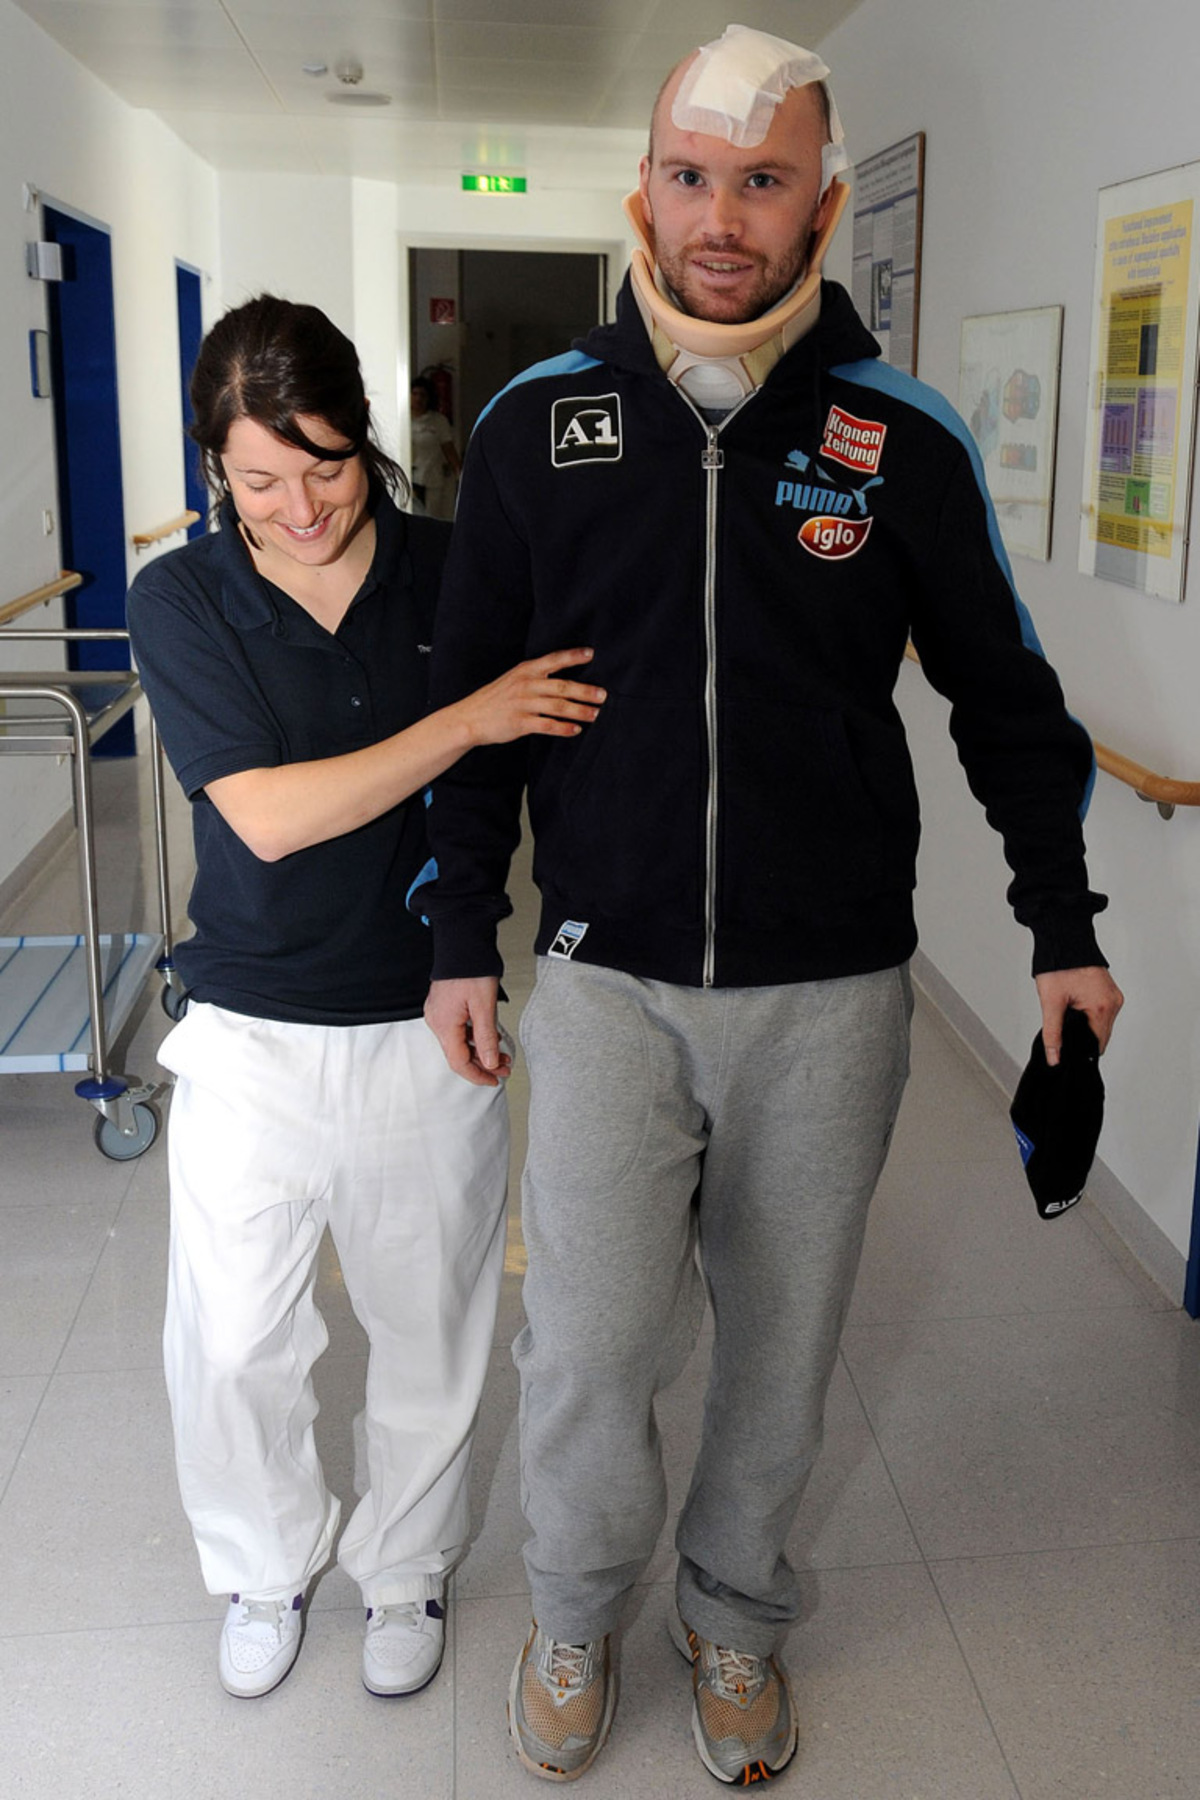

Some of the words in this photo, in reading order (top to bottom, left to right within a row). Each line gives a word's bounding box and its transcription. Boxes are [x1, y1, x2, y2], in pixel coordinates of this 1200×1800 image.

[556, 412, 618, 450] A1
[828, 412, 881, 445] Kronen
[824, 432, 878, 466] Zeitung
[775, 480, 854, 515] PUMA
[813, 521, 855, 551] iglo
